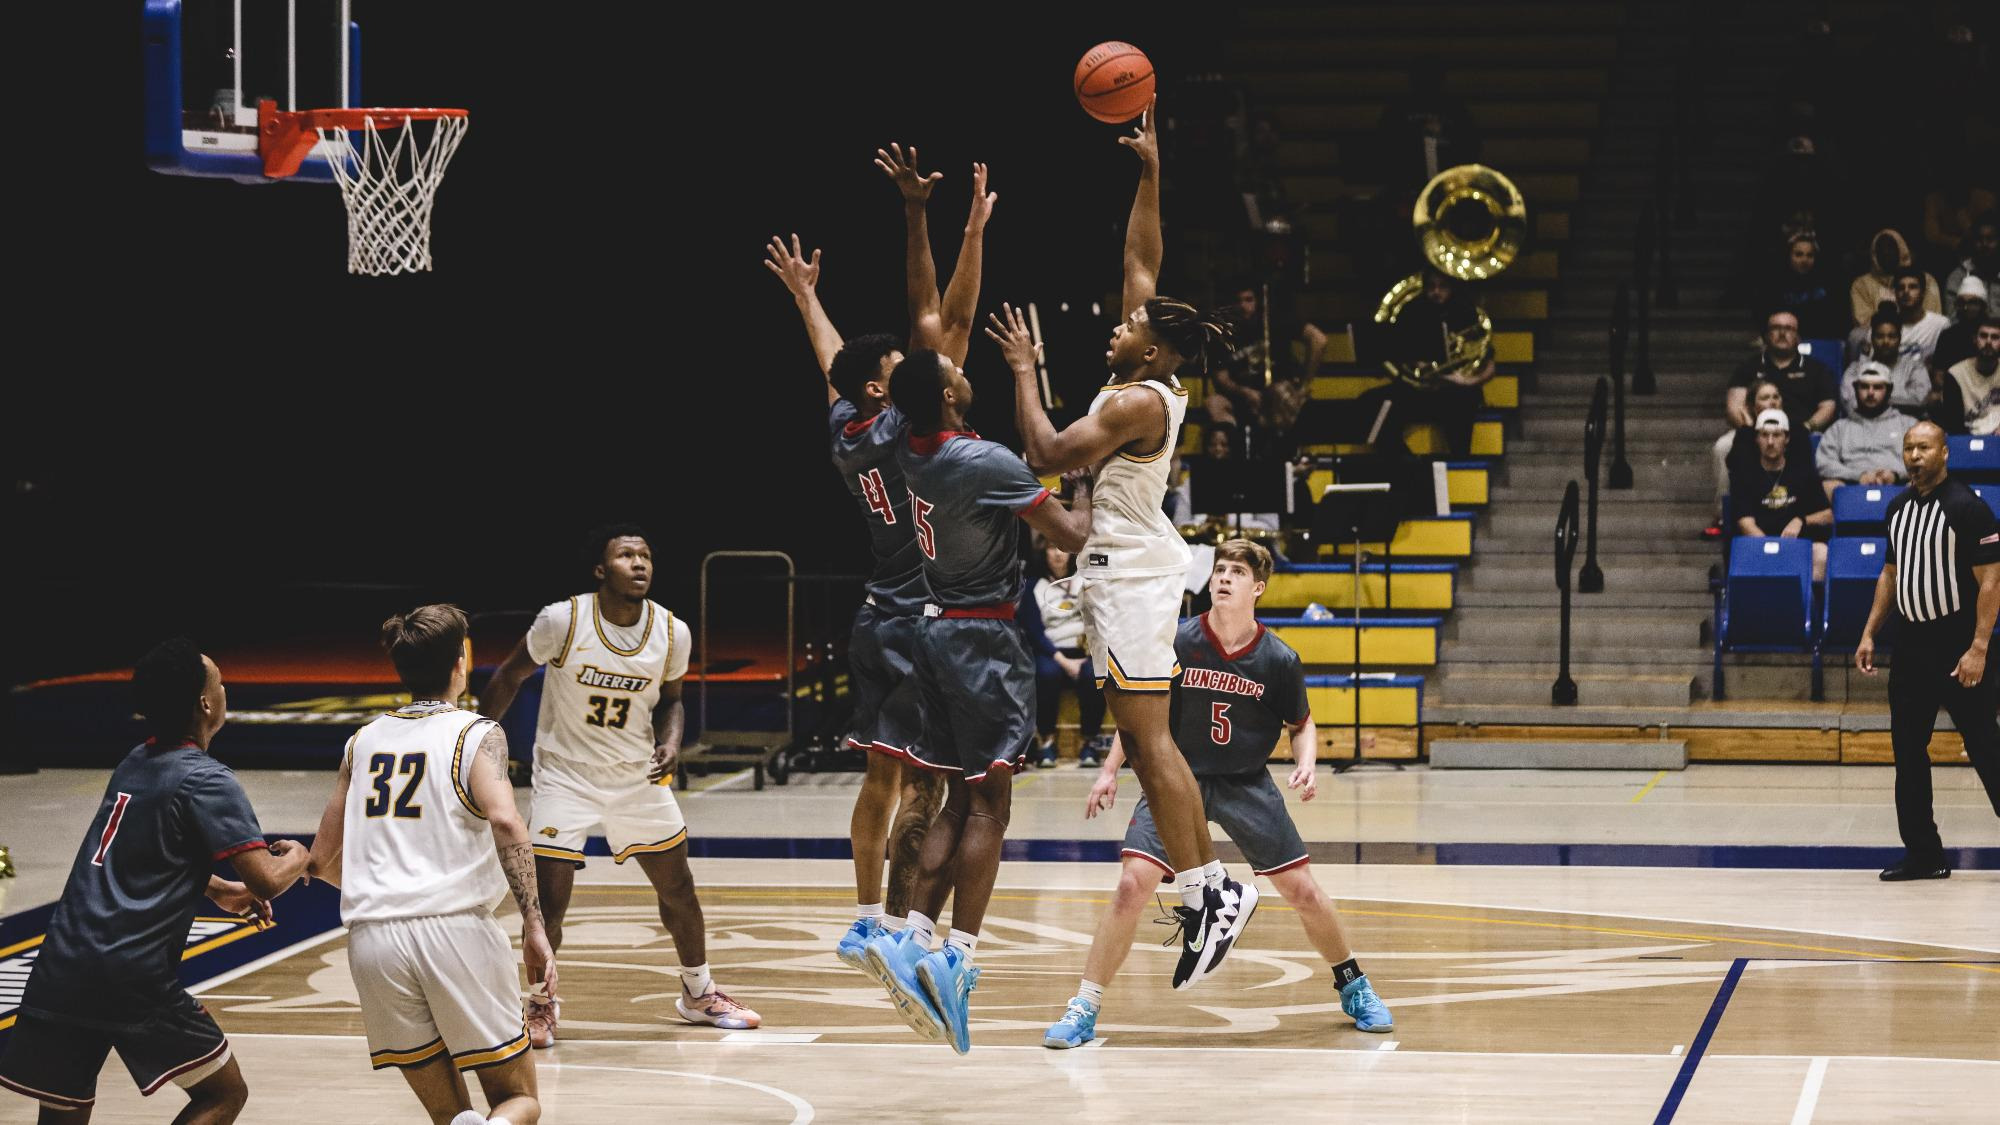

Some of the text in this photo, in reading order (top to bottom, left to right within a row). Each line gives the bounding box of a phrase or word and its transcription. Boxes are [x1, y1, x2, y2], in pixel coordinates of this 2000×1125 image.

[859, 468, 896, 525] 4
[906, 486, 936, 561] 5
[577, 664, 652, 692] AVERETT
[586, 695, 631, 729] 33
[1211, 701, 1232, 745] 5
[365, 751, 428, 819] 32
[91, 791, 132, 867] 1
